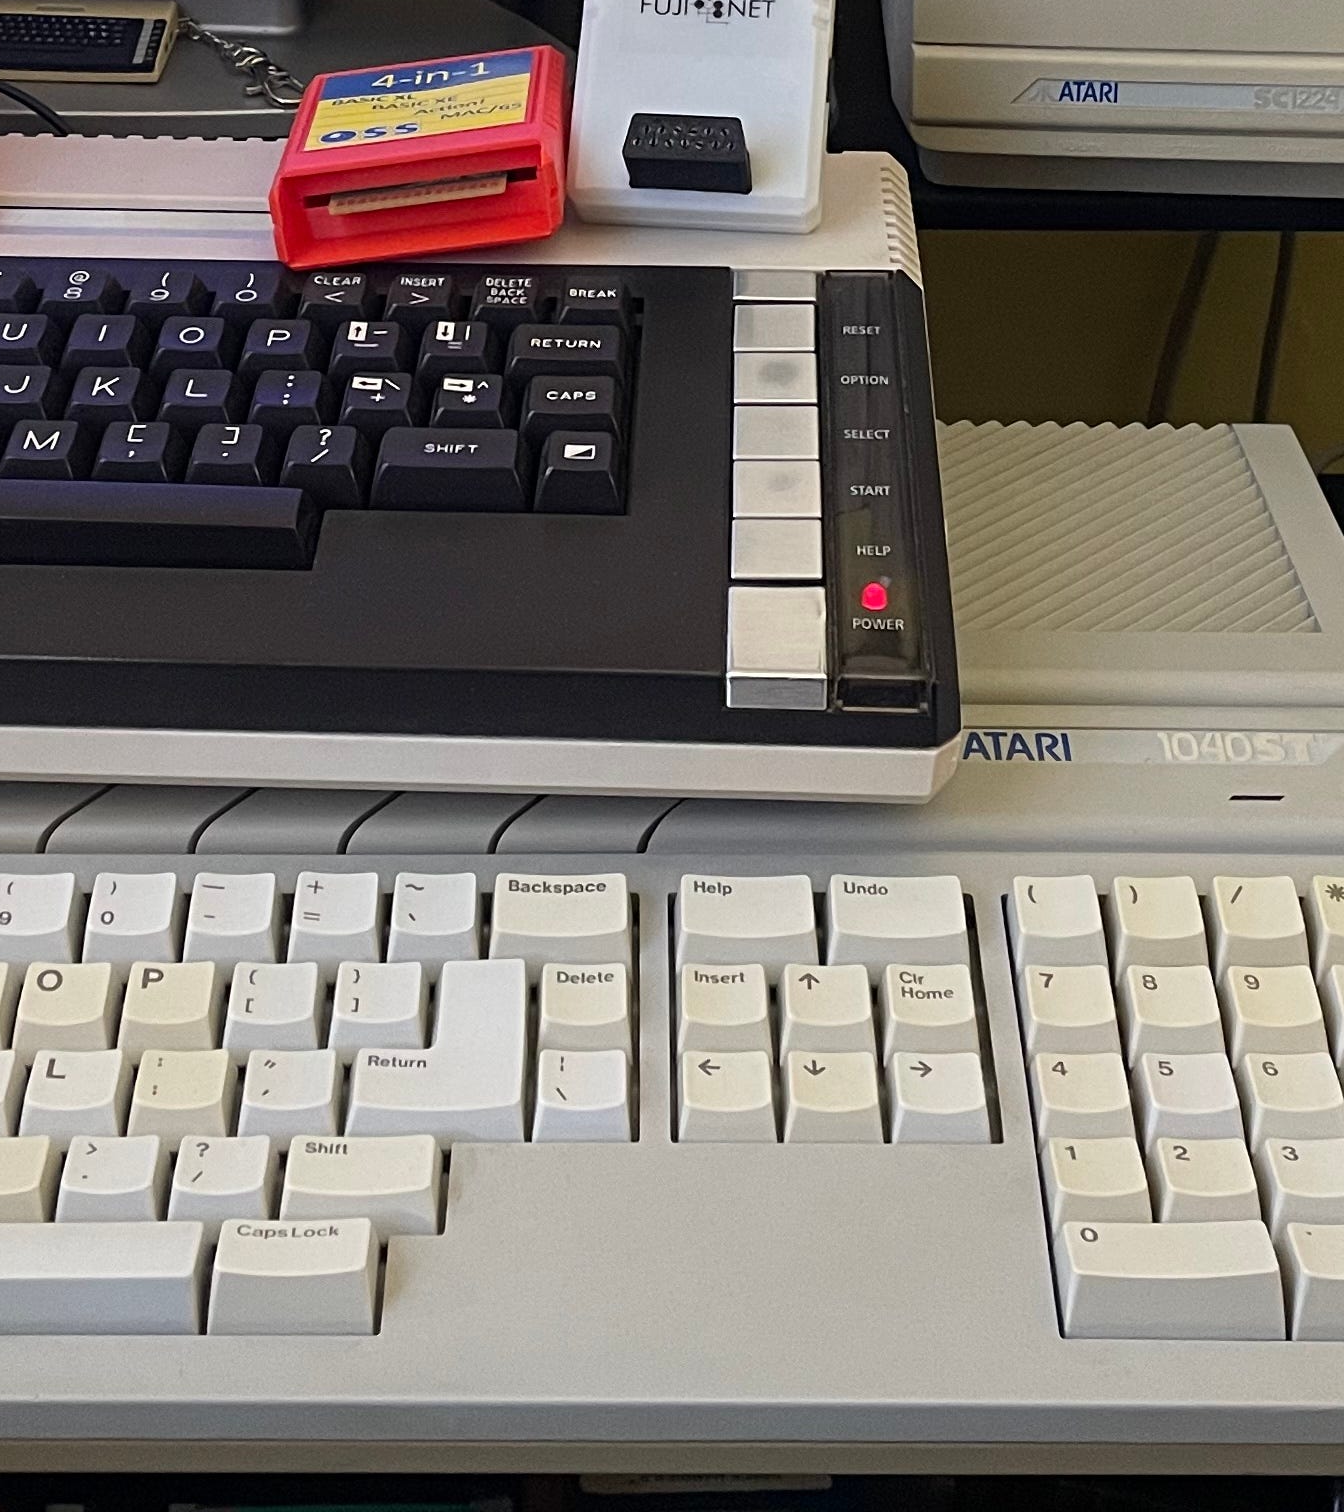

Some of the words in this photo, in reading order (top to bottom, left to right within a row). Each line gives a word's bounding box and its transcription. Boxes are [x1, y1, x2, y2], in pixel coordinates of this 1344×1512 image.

[727, 0, 776, 19] NET
[371, 62, 490, 88] 4-in-1
[332, 95, 388, 106] BASIC
[393, 94, 419, 102] XL
[1058, 80, 1119, 104] ATARI
[1254, 88, 1340, 111] SC1224
[372, 99, 430, 110] BASIC
[414, 98, 485, 115] Action!
[320, 122, 418, 143] OSS
[313, 275, 361, 286] CLEAR
[399, 276, 446, 288] INSERT
[485, 277, 532, 289] DELETE
[486, 295, 528, 304] SPACE
[489, 288, 525, 297] BACK
[569, 288, 617, 298] BREAK
[2, 323, 28, 341] U
[98, 324, 107, 342] I
[179, 326, 205, 344] O
[266, 329, 291, 347] P
[842, 324, 881, 336] RESET
[530, 338, 601, 350] RETURN
[4, 375, 30, 394] J
[91, 376, 120, 396] K
[185, 379, 208, 398] L
[840, 374, 890, 387] OPTION
[546, 390, 596, 402] CAPS
[23, 430, 60, 450] M
[843, 428, 890, 440] SELECT
[423, 443, 478, 455] SHIFT
[849, 484, 891, 497] START
[856, 544, 891, 558] HELP
[852, 617, 905, 632] POWER
[962, 731, 1072, 762] ATARI
[1160, 732, 1318, 763] 1040ST
[507, 879, 607, 896] Backspace
[693, 880, 733, 898] Help
[843, 881, 889, 897] Undo
[36, 969, 63, 992] O
[141, 967, 165, 989] P
[555, 970, 615, 985] Delete
[693, 970, 745, 985] Insert
[898, 971, 924, 986] Clr
[1039, 972, 1054, 989] 7
[1141, 974, 1158, 991] 8
[1243, 974, 1260, 990] 9
[900, 986, 954, 1001] Home
[45, 1058, 66, 1080] L
[367, 1055, 428, 1070] Return
[1158, 1060, 1174, 1077] 5
[1261, 1061, 1279, 1077] 6
[304, 1140, 349, 1156] Shift
[1173, 1145, 1190, 1161] 2
[1281, 1145, 1299, 1162] 3
